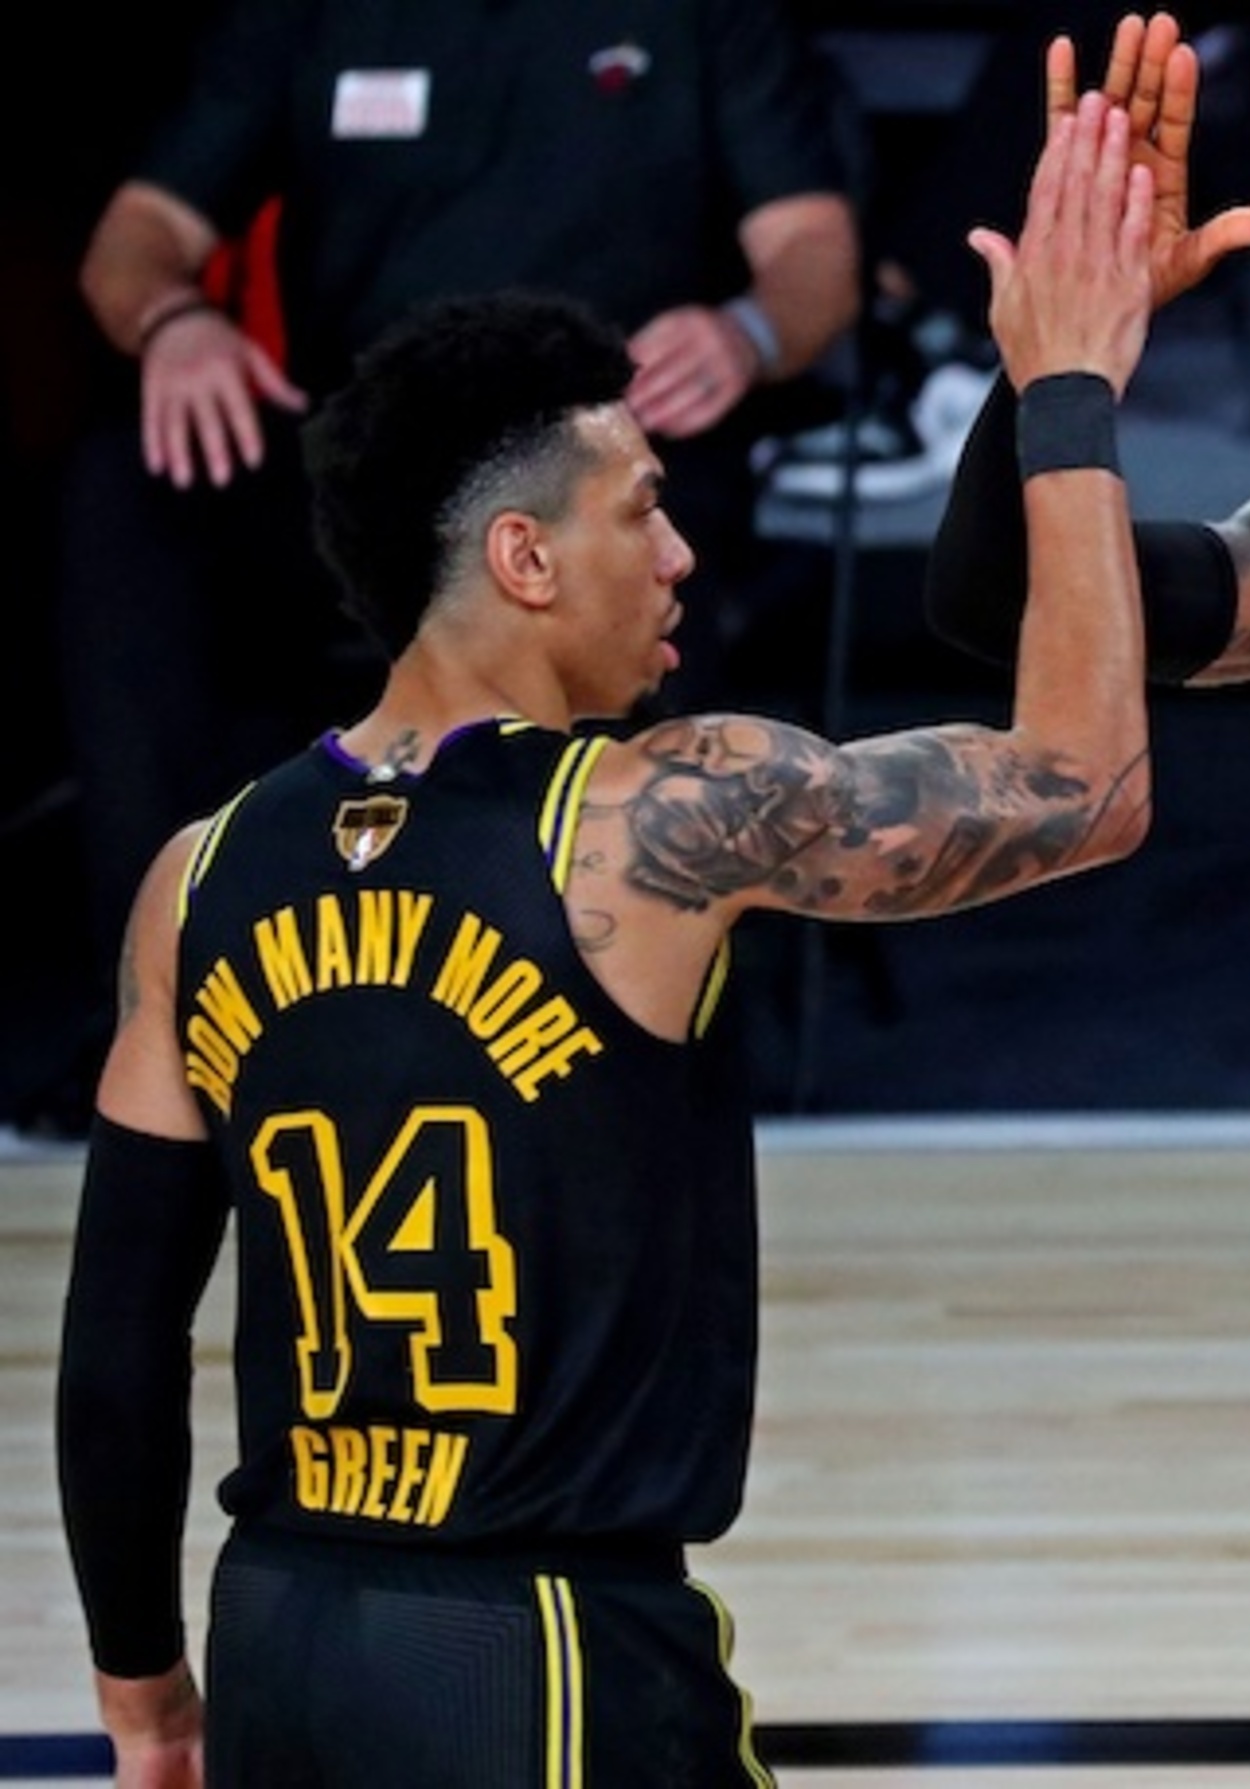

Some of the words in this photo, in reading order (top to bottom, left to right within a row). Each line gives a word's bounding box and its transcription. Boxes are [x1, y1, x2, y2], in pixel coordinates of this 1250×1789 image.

[253, 889, 434, 1011] MANY
[430, 911, 604, 1104] MORE
[249, 1104, 518, 1421] 14
[290, 1423, 470, 1529] GREEN
